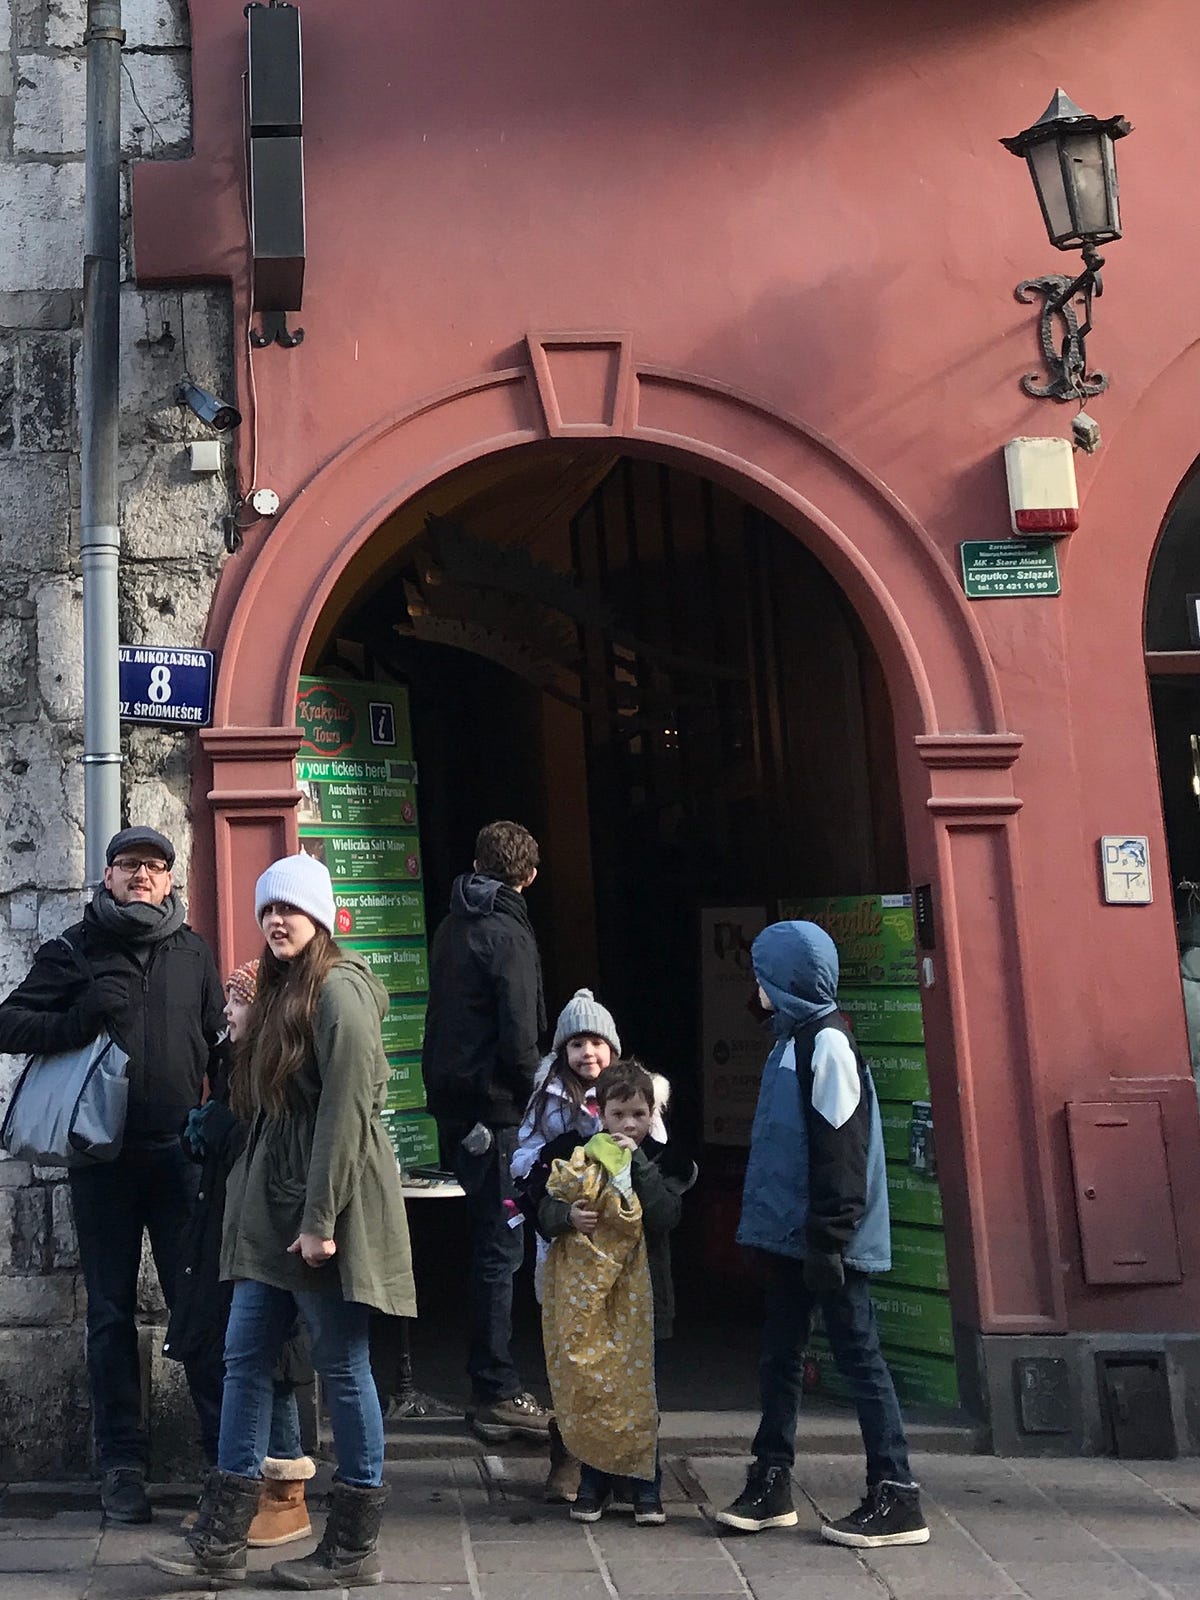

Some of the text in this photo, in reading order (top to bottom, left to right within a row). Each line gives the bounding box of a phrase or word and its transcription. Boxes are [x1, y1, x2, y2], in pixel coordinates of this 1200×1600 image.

[968, 571, 1009, 582] Legutko
[134, 650, 206, 668] MIKOŁAJSKA
[148, 665, 172, 703] 8
[134, 700, 203, 721] ŚRÓDMIEŚCIE
[313, 725, 341, 743] Tours
[308, 763, 330, 779] your
[331, 761, 363, 777] tickets
[328, 784, 368, 796] Auschwitz
[332, 838, 405, 851] Wieliczka Salt Mine
[336, 894, 419, 907] Oscar Schindler's Sites
[372, 953, 392, 964] River
[394, 951, 420, 965] Rafting
[392, 1068, 410, 1081] Trail
